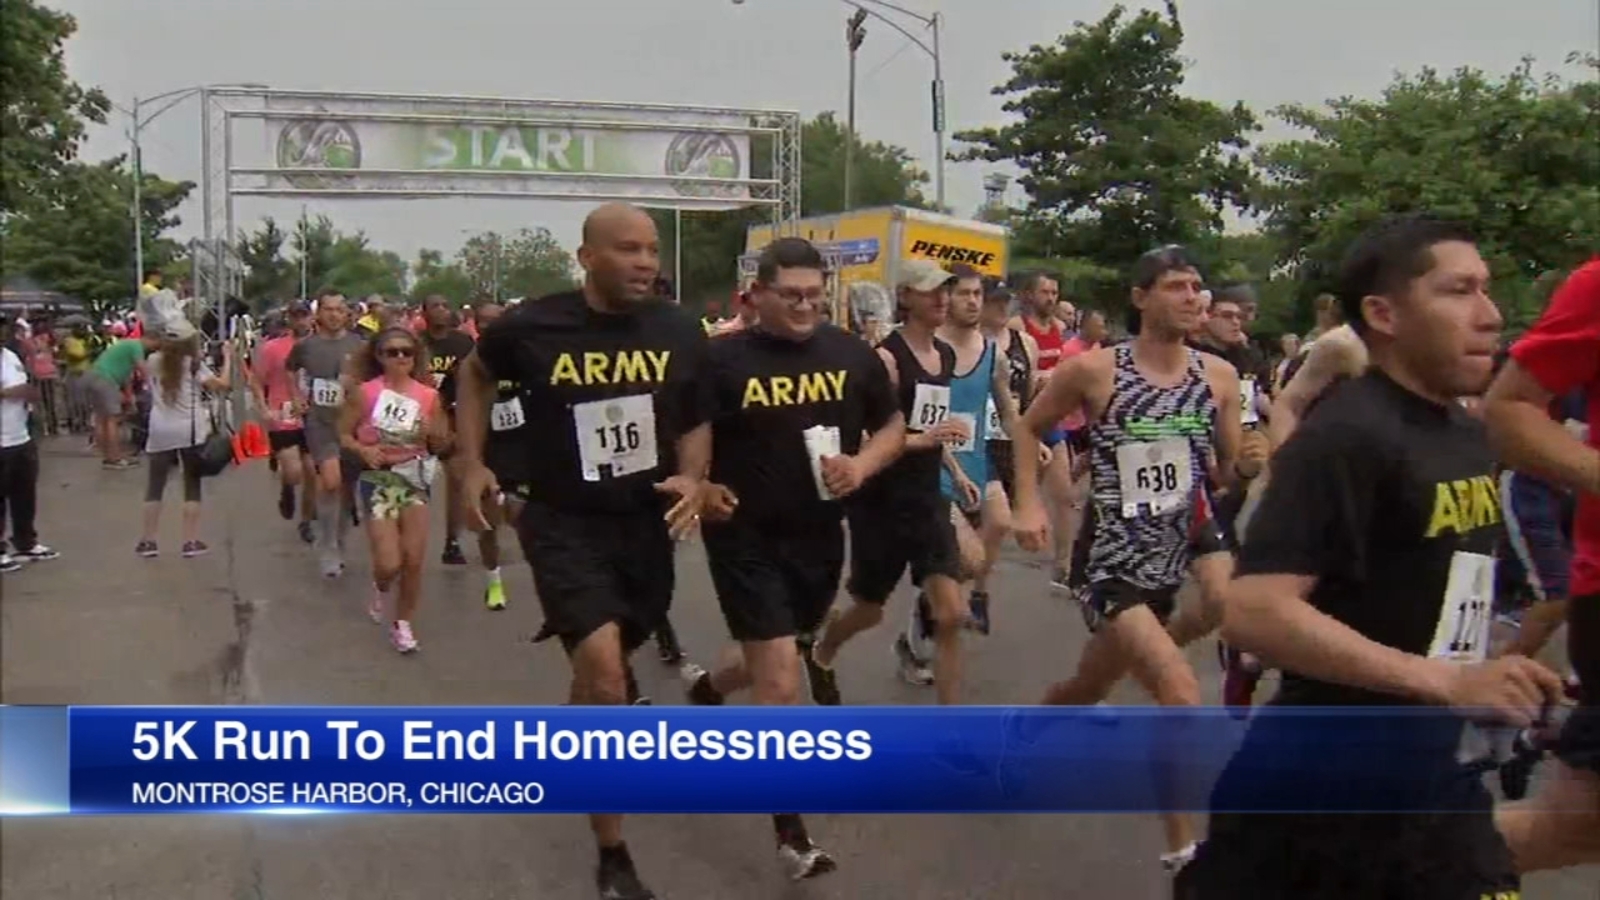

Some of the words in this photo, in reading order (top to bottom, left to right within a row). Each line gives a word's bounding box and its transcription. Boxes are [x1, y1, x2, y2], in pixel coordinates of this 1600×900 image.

[424, 124, 607, 170] START
[910, 240, 996, 266] PENSKE
[551, 350, 670, 385] ARMY
[742, 370, 847, 408] ARMY
[920, 403, 947, 425] 637
[595, 421, 640, 454] 116
[1136, 462, 1178, 493] 638
